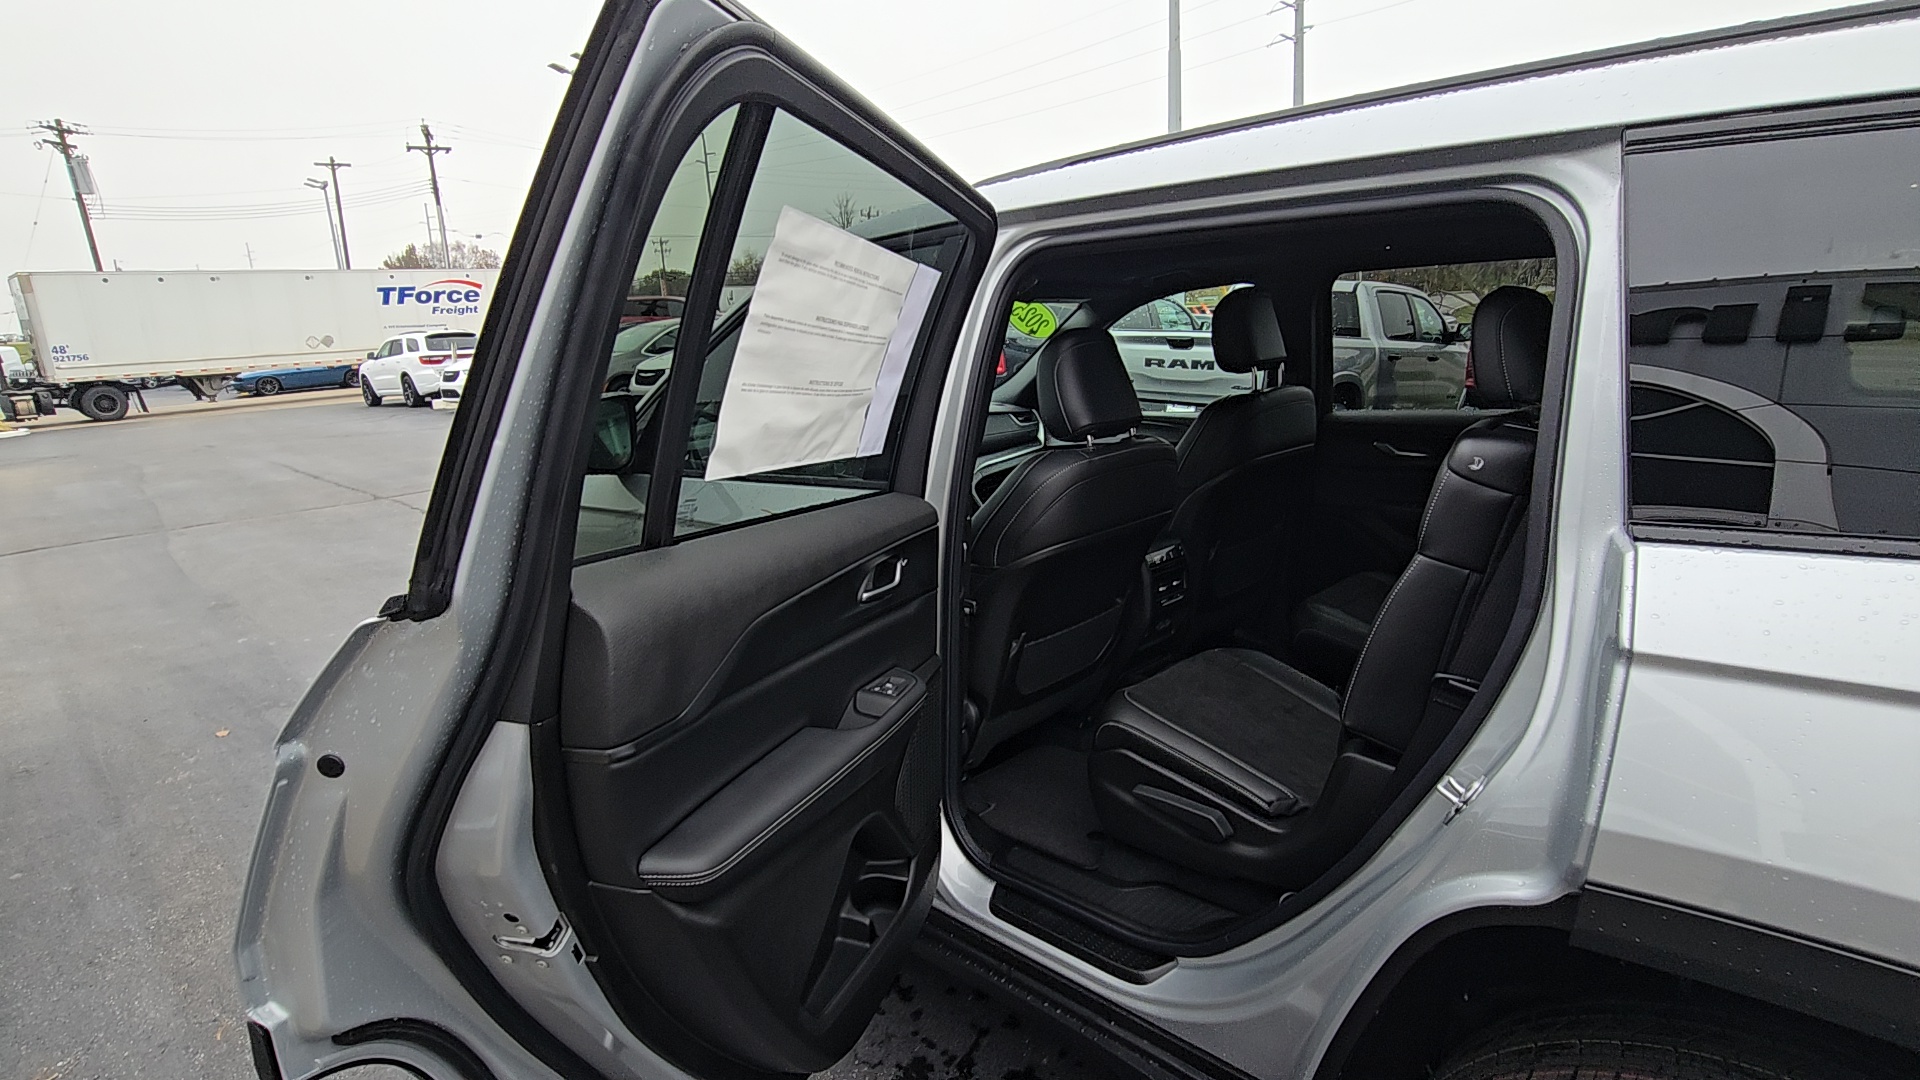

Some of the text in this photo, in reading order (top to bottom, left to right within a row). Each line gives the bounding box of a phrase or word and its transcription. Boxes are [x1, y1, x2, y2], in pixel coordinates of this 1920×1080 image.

[376, 286, 480, 305] TForce
[432, 305, 478, 316] Freight
[52, 353, 89, 362] 921756
[1144, 357, 1215, 370] RAM
